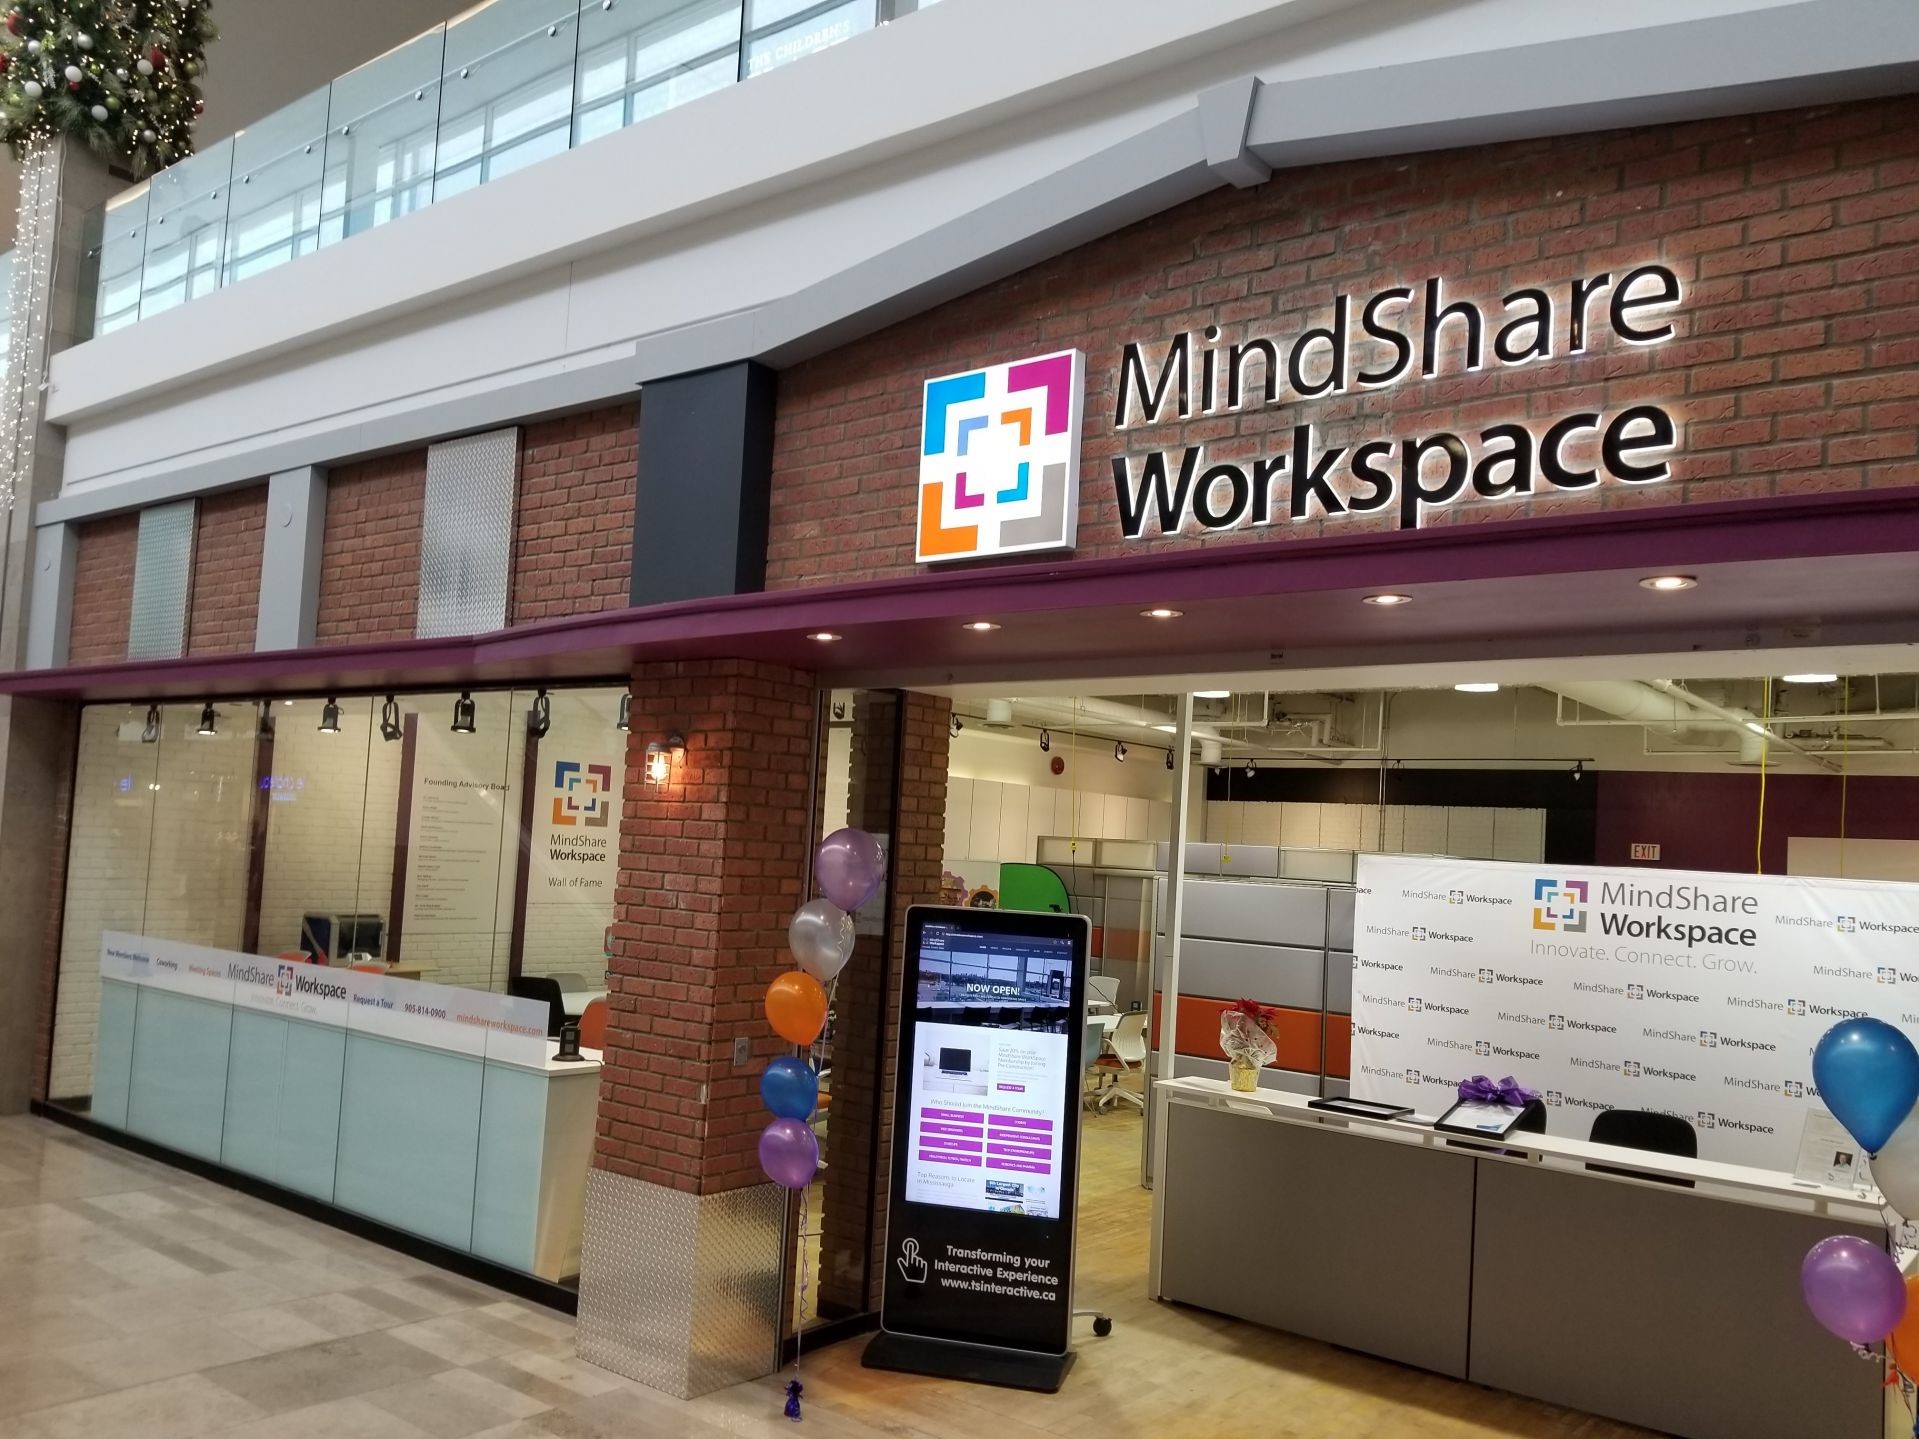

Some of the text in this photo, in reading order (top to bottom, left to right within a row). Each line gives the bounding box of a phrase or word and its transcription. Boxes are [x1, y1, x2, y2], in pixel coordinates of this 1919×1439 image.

[1114, 264, 1681, 429] MindShare
[1111, 404, 1677, 538] Workspace
[424, 778, 457, 788] Founding
[459, 780, 489, 791] Advisory
[550, 834, 607, 848] MindShare
[550, 849, 606, 864] Workspace
[1634, 845, 1657, 859] EXIT
[548, 877, 603, 888] Wall of Fame
[1402, 889, 1513, 906] MindShare Workspace
[1601, 882, 1758, 914] MindShare
[1600, 912, 1757, 948] Workspace
[1775, 915, 1919, 934] MindShare Workspace
[1366, 926, 1474, 943] MindShare Workspace
[157, 958, 178, 971] Coworking
[1361, 959, 1404, 972] Workspace
[1530, 940, 1757, 974] Innovate. Connect. Grow.
[227, 963, 347, 1000] MindShare Workspace
[1430, 967, 1543, 986] MindShare Workspace
[1813, 966, 1873, 980] MindShare
[967, 983, 1020, 996] NOW OPEN!
[1573, 982, 1700, 1003] MindShare Workspace
[353, 994, 376, 1006] Request
[380, 998, 394, 1009] Tour
[404, 1003, 446, 1019] 905-814-0900
[1362, 994, 1470, 1015] MindShare Workspace
[1727, 996, 1868, 1018] MindShare Workspace
[456, 1013, 544, 1036] mindshareworkspace.com
[1358, 1026, 1400, 1039] Workspace
[1497, 1012, 1617, 1034] MindShare Workspace
[1427, 1037, 1540, 1061] MindShare Workspace
[1643, 1028, 1776, 1052] MindShare Workspace
[1361, 1065, 1404, 1079] MindShare
[1570, 1057, 1697, 1082] MindShare Workspace
[1724, 1076, 1781, 1092] MindShare
[1564, 1096, 1615, 1112] Workspace
[1718, 1117, 1775, 1134] Workspace
[947, 1245, 1050, 1268] Transforming your
[934, 1259, 1059, 1286] Interactive Experience
[941, 1277, 1056, 1301] www.tsinteractive.ca
